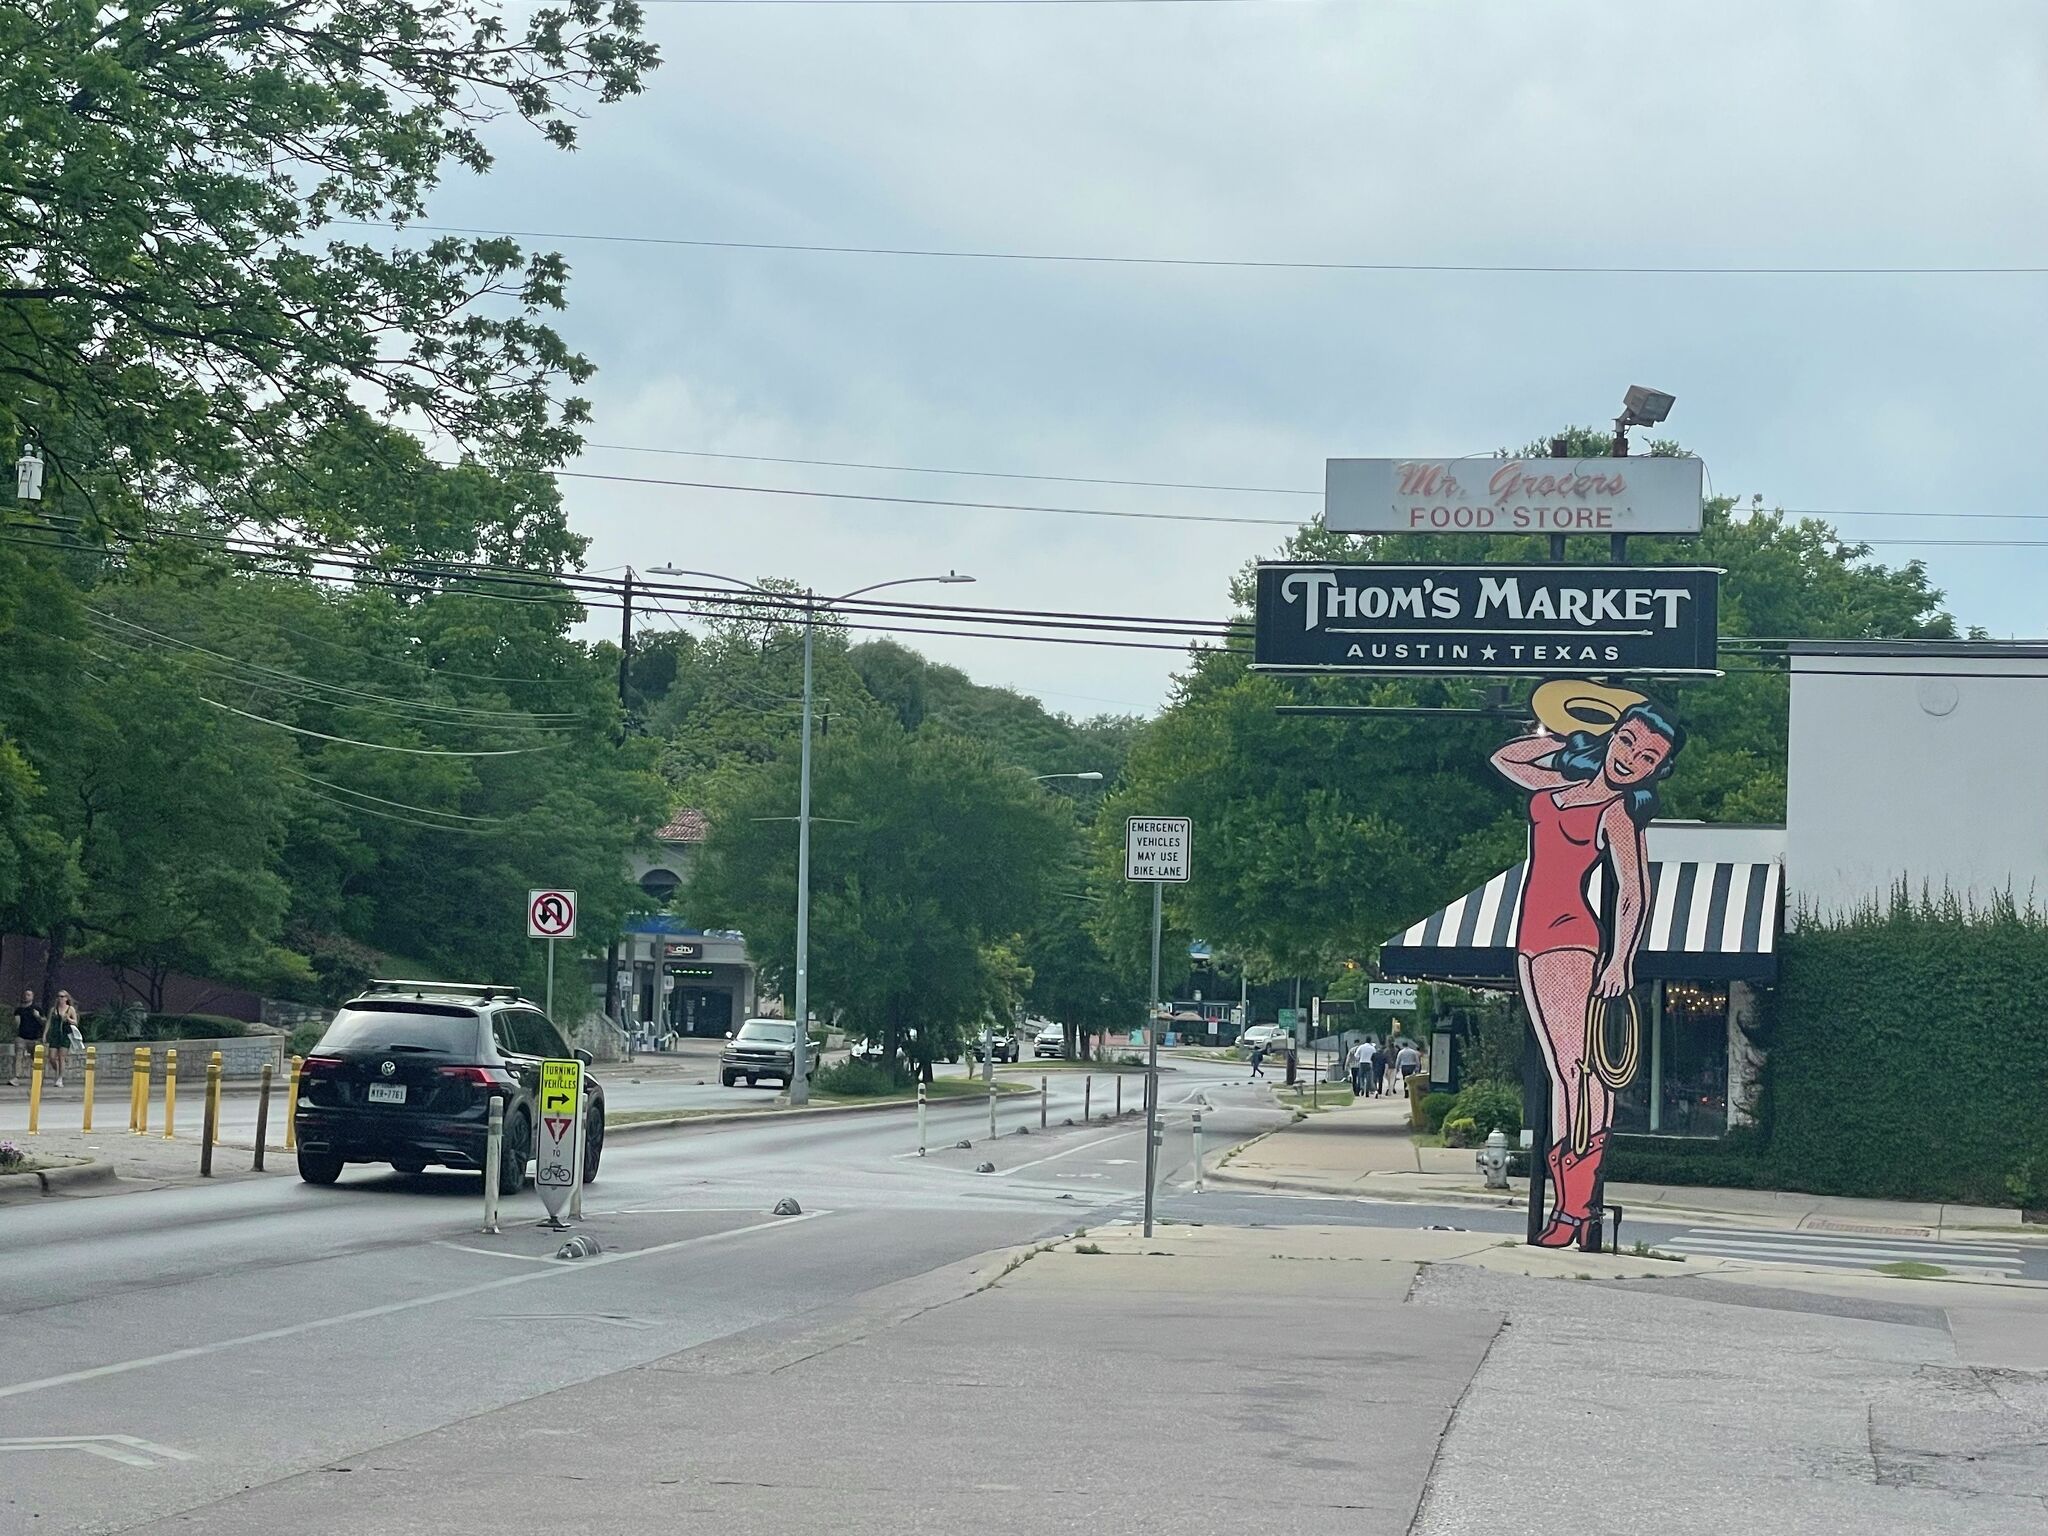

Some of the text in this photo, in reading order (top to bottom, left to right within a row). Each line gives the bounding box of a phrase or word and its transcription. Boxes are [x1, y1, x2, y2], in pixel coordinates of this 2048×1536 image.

[1396, 460, 1627, 507] Mr. Grocers
[1410, 506, 1613, 528] FOOD STORE
[1281, 571, 1692, 631] THOM'S MARKET
[1347, 643, 1620, 661] AUSTIN TEXAS
[1131, 822, 1186, 833] EMERGENCY
[1136, 837, 1181, 847] VEHICLES
[1137, 851, 1179, 862] MAY USE
[1133, 865, 1182, 877] BIKE LANE
[1372, 987, 1403, 997] PECAN
[545, 1065, 576, 1076] TURNING
[543, 1078, 577, 1089] VEHICLES
[552, 1149, 561, 1157] TO
